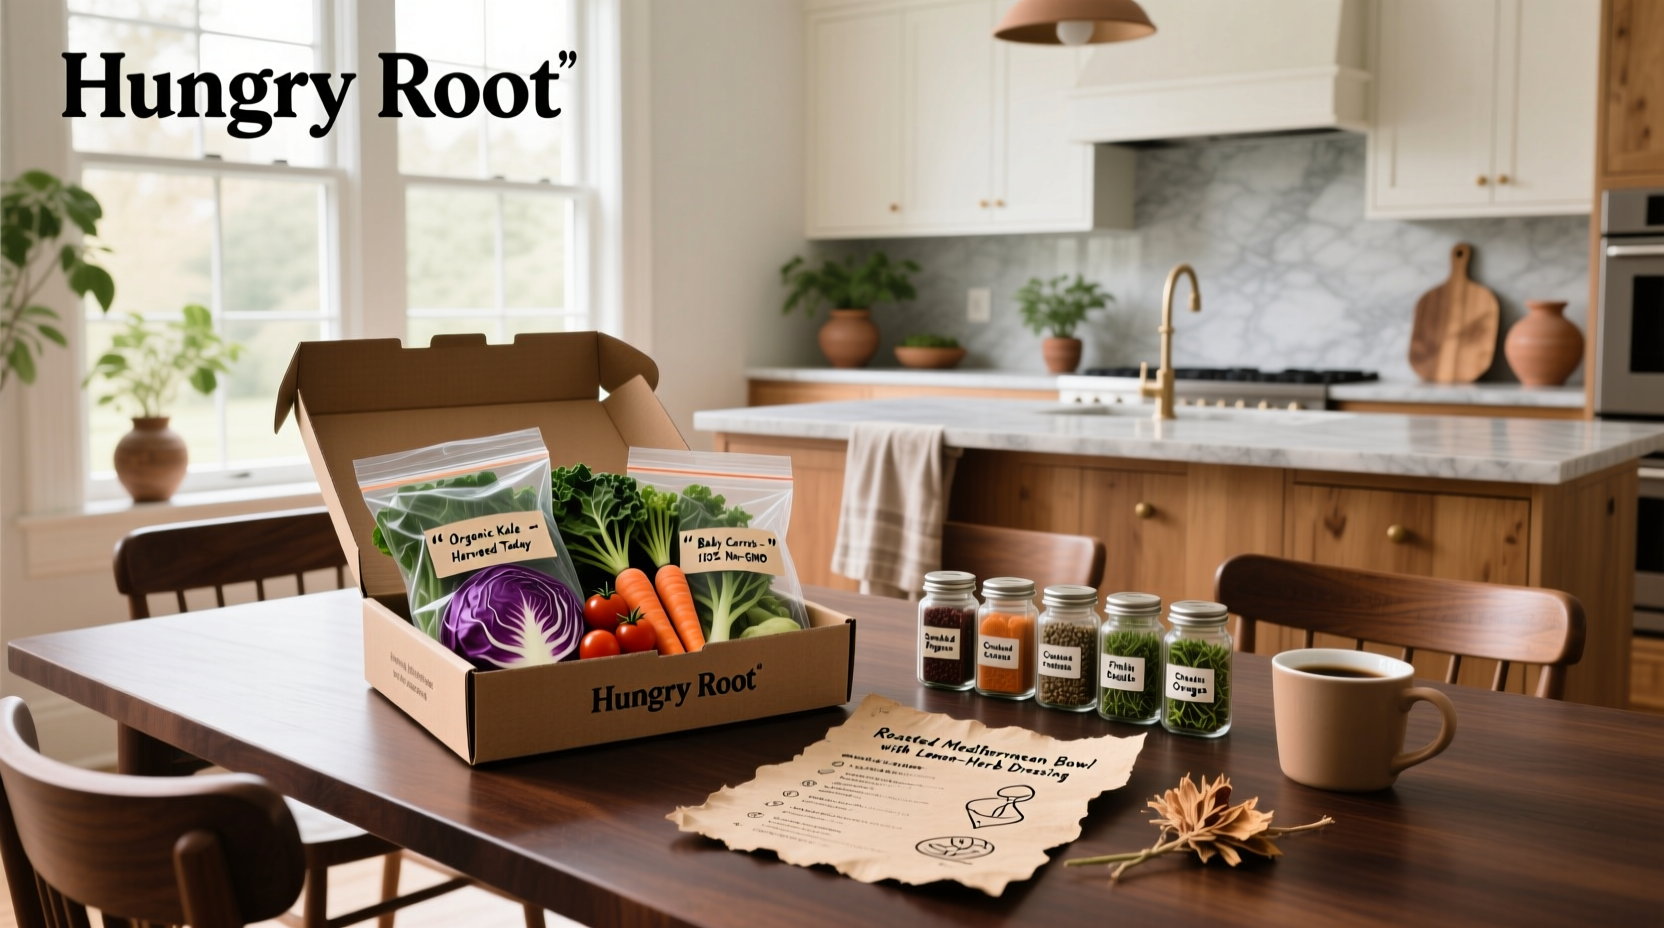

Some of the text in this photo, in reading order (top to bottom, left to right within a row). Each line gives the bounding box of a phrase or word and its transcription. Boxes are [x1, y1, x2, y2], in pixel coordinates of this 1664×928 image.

[449, 528, 494, 546] Organic
[496, 522, 521, 536] Kale
[697, 536, 722, 550] Baby
[591, 682, 692, 714] Hungry
[1053, 756, 1098, 770] Bowl
